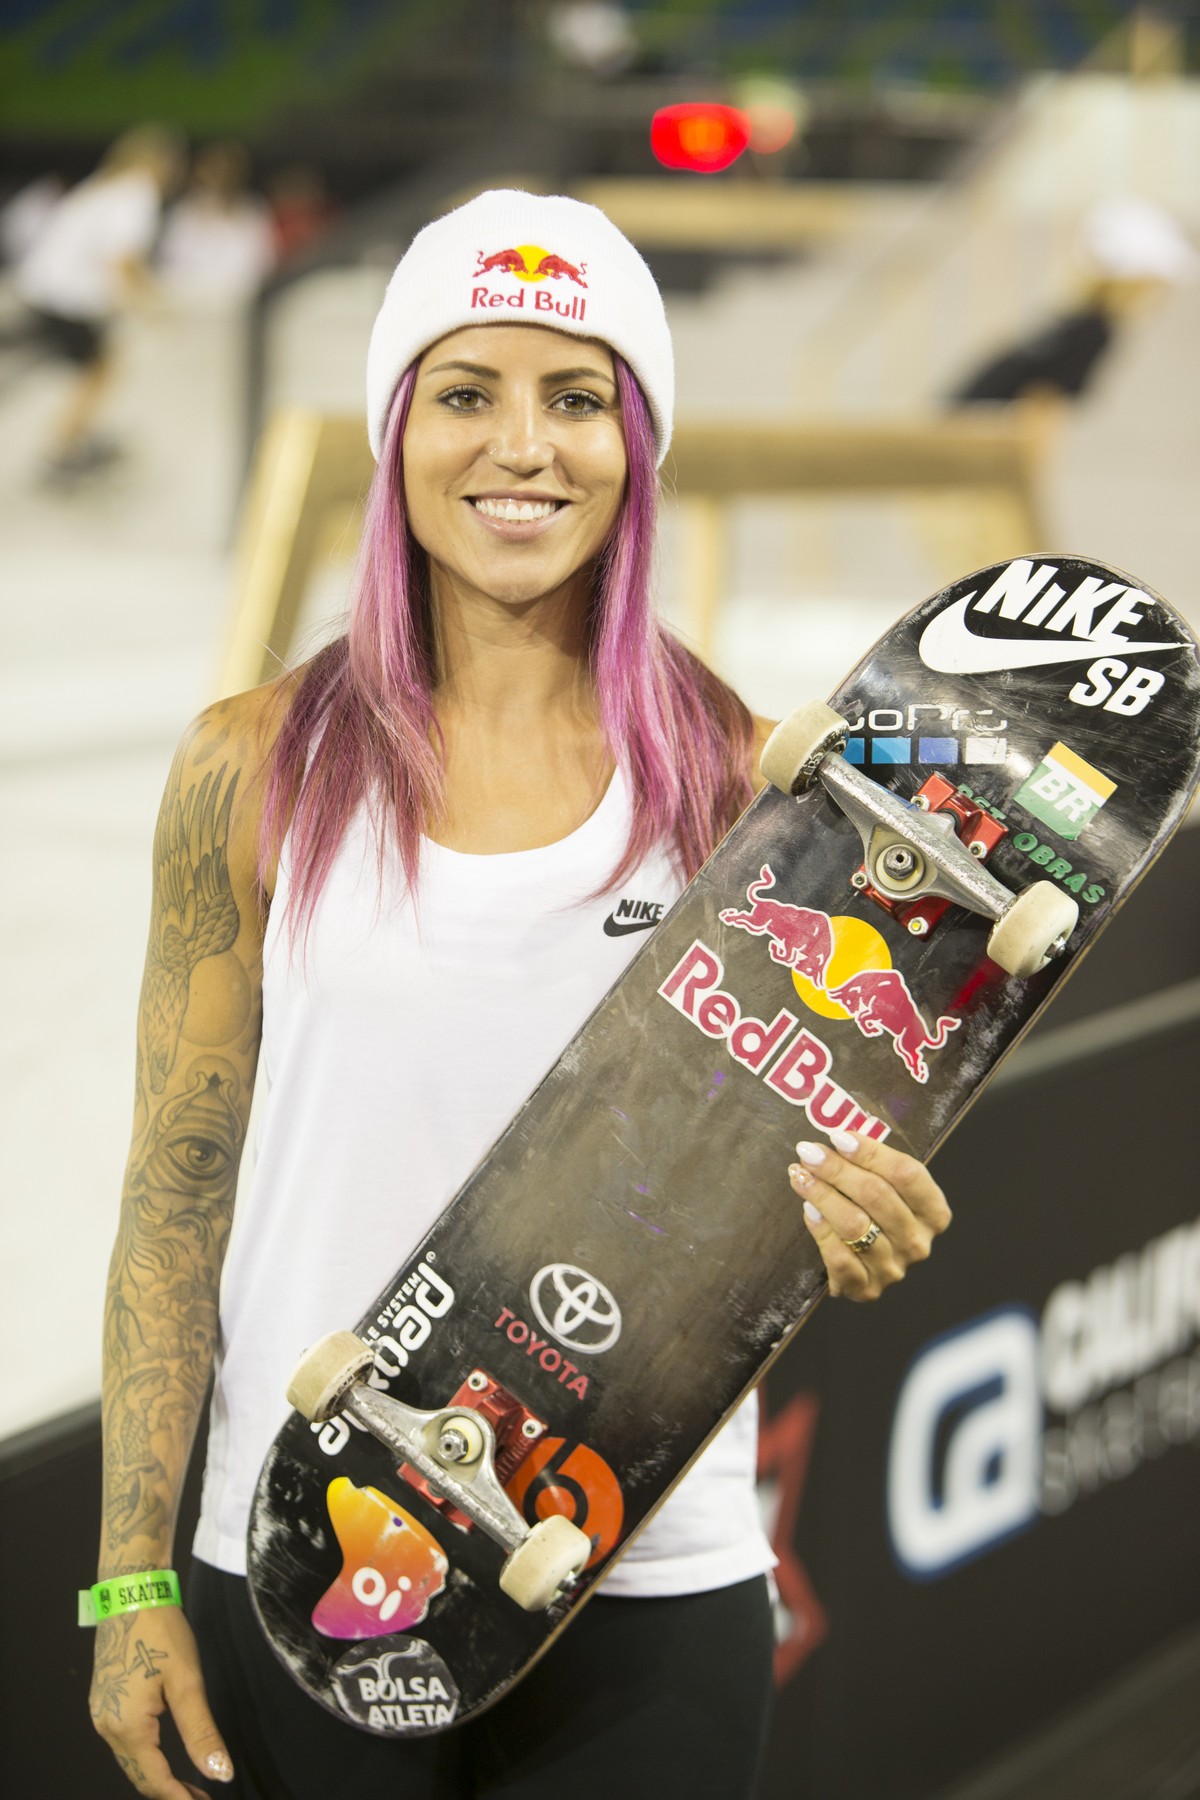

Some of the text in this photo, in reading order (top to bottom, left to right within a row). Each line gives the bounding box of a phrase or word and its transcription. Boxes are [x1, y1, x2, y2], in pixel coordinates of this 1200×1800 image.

[471, 287, 587, 321] Red Bull
[973, 559, 1156, 643] NIKE
[1068, 658, 1165, 716] SB
[1029, 769, 1092, 823] BR
[615, 898, 664, 921] NIKE
[658, 940, 797, 1075] Red
[376, 1271, 423, 1329] SYSTEM
[493, 1306, 590, 1400] TOYOTA
[118, 1580, 173, 1606] SKATER
[358, 1676, 450, 1702] BOLSA
[367, 1703, 453, 1731] ATLETA
